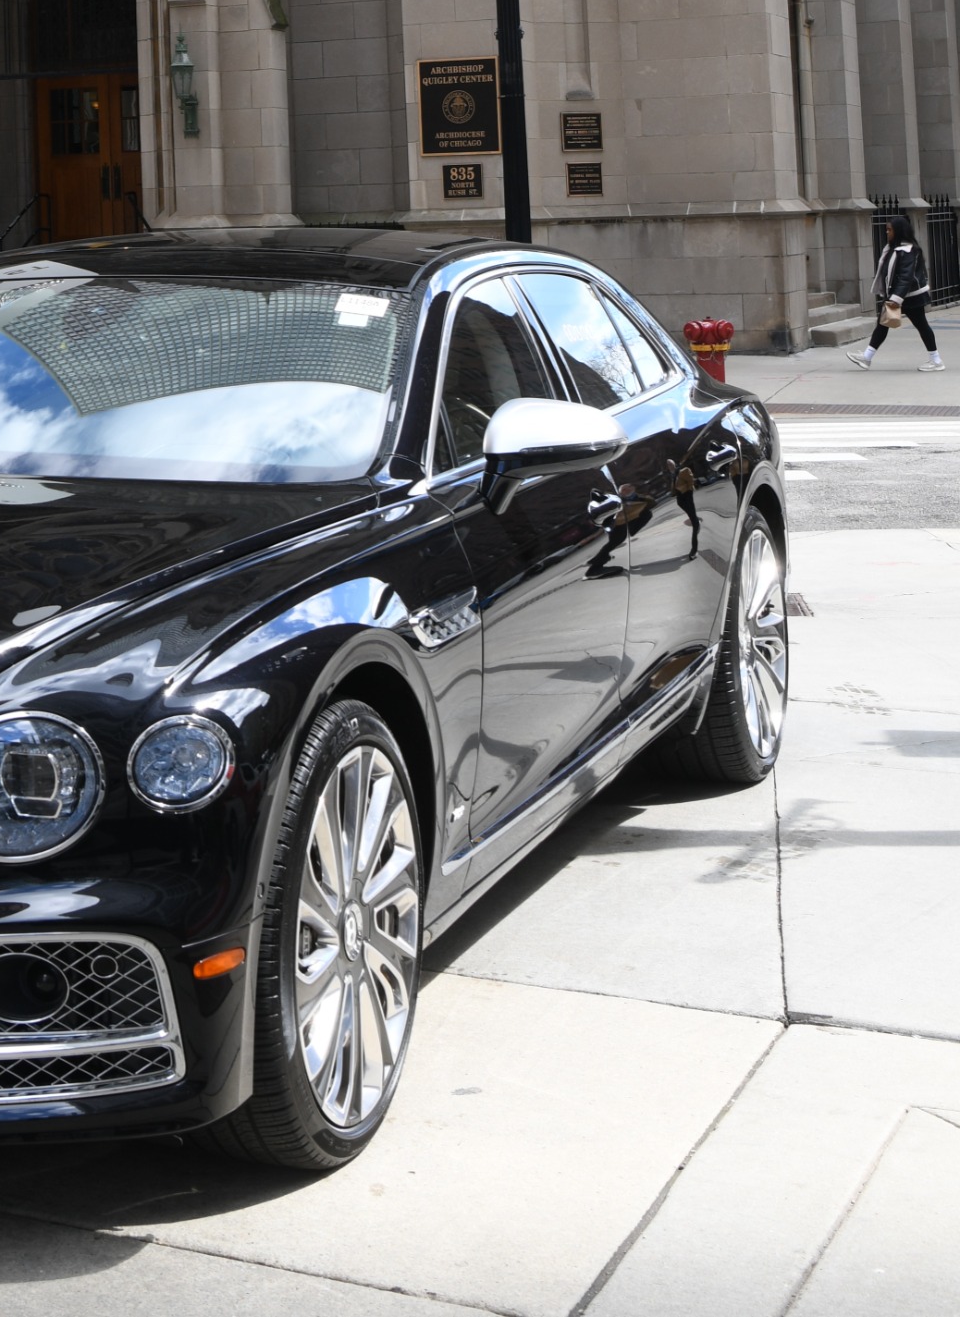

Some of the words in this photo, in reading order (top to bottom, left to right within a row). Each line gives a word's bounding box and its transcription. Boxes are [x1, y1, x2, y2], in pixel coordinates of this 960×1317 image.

[430, 64, 484, 75] ARCHBISHOP
[422, 75, 459, 86] QUIGLEY
[459, 74, 494, 84] CENTER
[435, 130, 486, 139] ARCHDIOCESE
[438, 140, 449, 148] OF
[449, 139, 482, 148] CHICAGO
[449, 166, 475, 181] 835
[451, 181, 475, 189] NORTH
